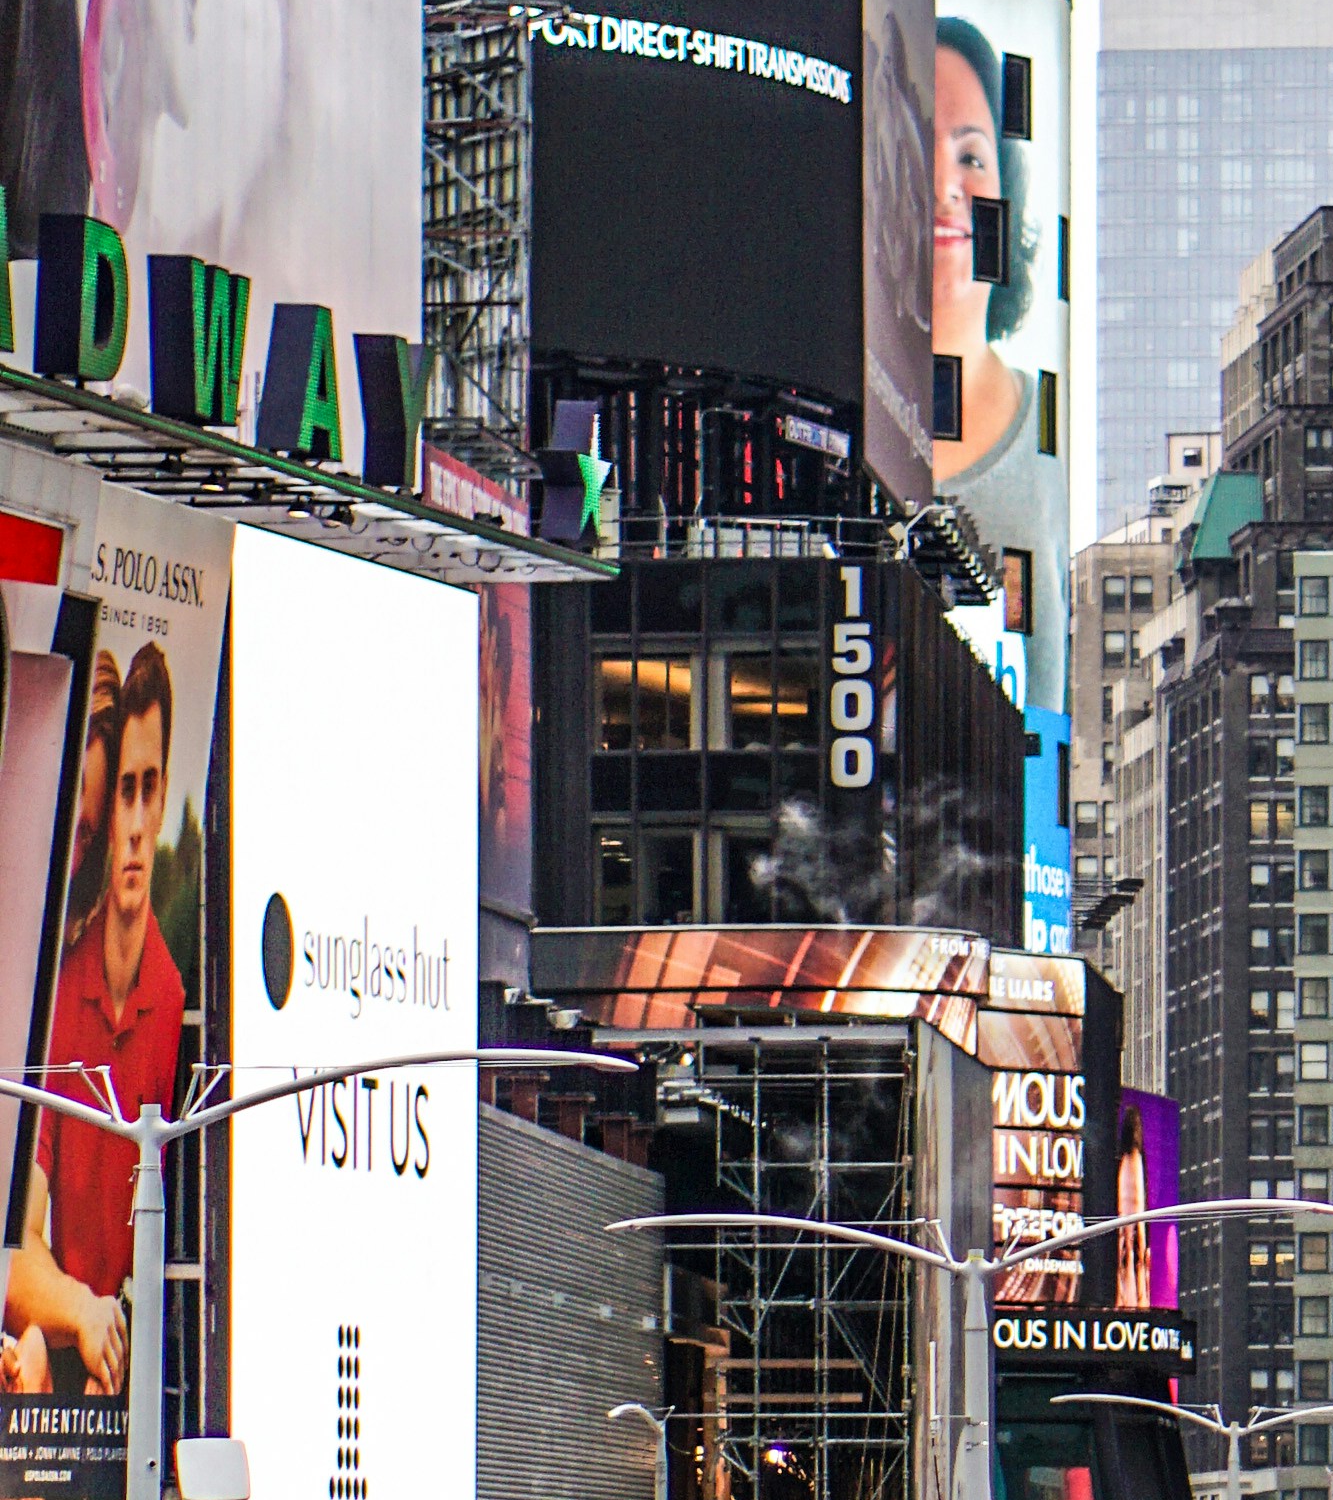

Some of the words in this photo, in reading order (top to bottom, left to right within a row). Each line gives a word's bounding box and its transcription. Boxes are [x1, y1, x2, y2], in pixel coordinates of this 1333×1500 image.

[746, 40, 853, 104] TRANSMISSIONS
[113, 551, 156, 597] POLO
[159, 560, 204, 609] ASSN.
[100, 603, 138, 630] SINCE
[141, 611, 170, 638] 1890
[829, 565, 875, 789] 1500
[303, 915, 407, 1020] sunglass
[412, 924, 452, 1012] hut
[1008, 979, 1055, 1002] LIARS
[390, 1083, 430, 1180] US
[998, 1133, 1038, 1176] IN
[992, 1318, 1047, 1349] OUS
[1053, 1319, 1087, 1350] IN
[1092, 1319, 1150, 1352] LOVE
[1150, 1324, 1168, 1351] ON
[9, 1407, 129, 1436] AUTHENTICALLY
